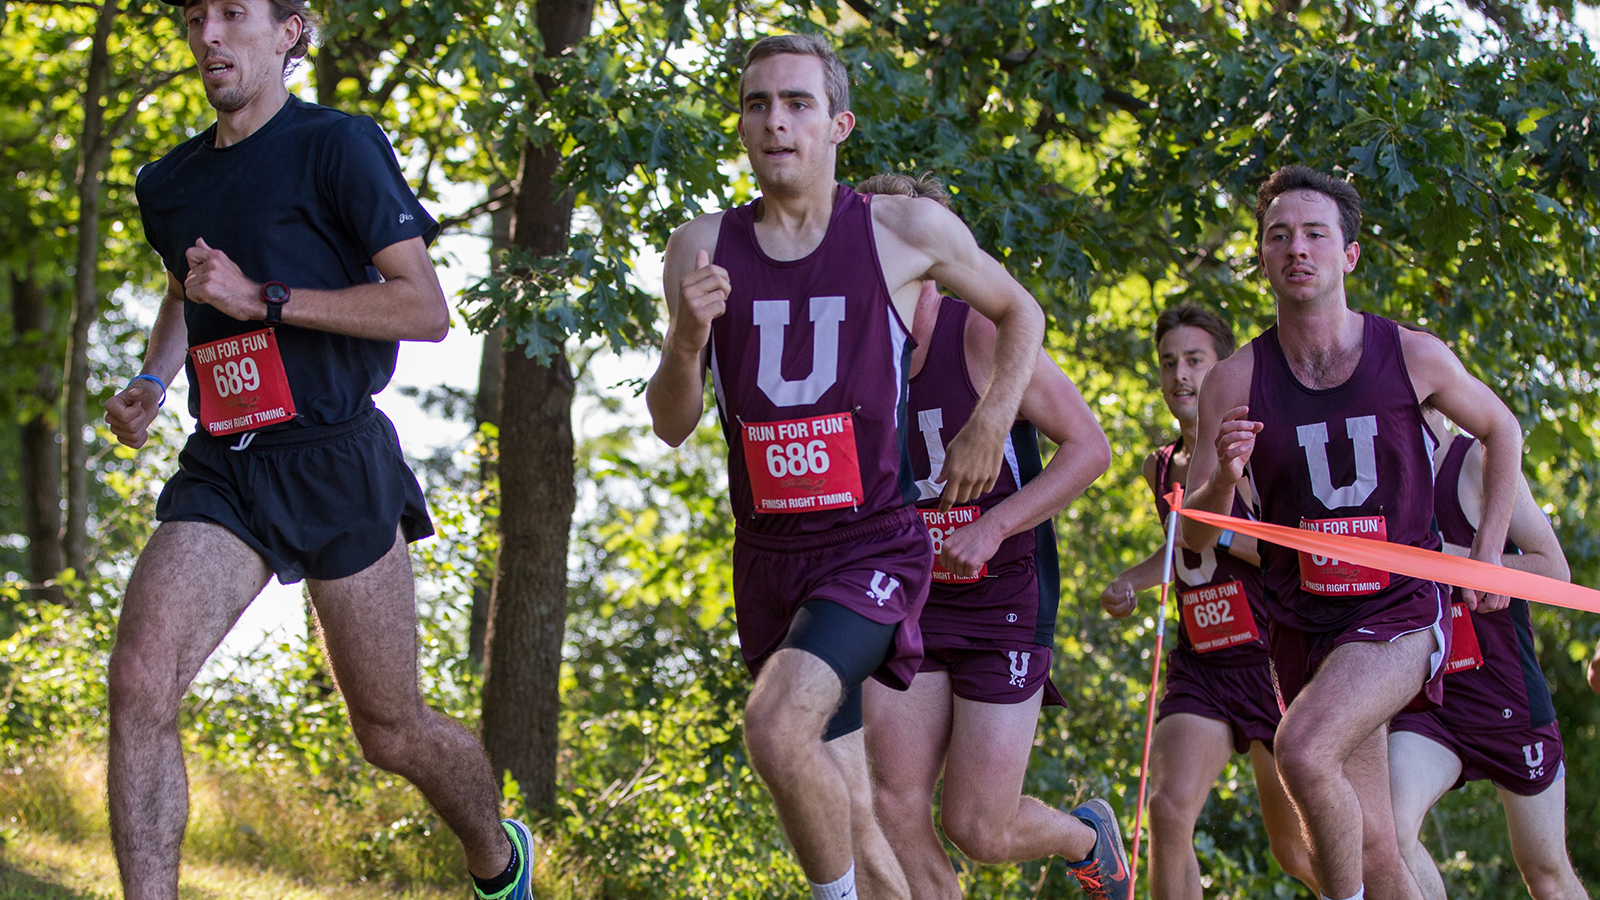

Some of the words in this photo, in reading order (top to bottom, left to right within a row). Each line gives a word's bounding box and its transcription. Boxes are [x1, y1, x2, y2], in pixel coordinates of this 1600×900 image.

[196, 346, 217, 364] RUN
[217, 340, 240, 359] FOR
[241, 333, 268, 353] FUN
[753, 295, 846, 408] U
[212, 357, 260, 398] 689
[209, 419, 233, 432] FINISH
[233, 414, 253, 428] RIGHT
[254, 407, 286, 423] TIMING
[748, 425, 775, 441] RUN
[778, 422, 809, 440] FOR
[812, 417, 844, 436] FUN
[766, 439, 830, 478] 686
[1296, 415, 1378, 511] U
[761, 499, 787, 509] FINISH
[788, 496, 816, 508] RIGHT
[817, 491, 853, 506] TIMING
[922, 512, 946, 525] FOR
[947, 509, 973, 524] FUN
[1322, 521, 1349, 535] FOR
[1352, 519, 1378, 534] FUN
[870, 569, 900, 600] U
[932, 571, 951, 580] RIGHT
[1305, 580, 1325, 592] FINISH
[1326, 583, 1350, 593] RIGHT
[1351, 582, 1381, 592] TIMING
[1183, 593, 1199, 606] RUN
[1199, 588, 1218, 602] FOR
[1218, 584, 1238, 598] FUN
[1193, 599, 1235, 629] 682
[1194, 640, 1212, 651] FINISH
[1211, 637, 1229, 647] RIGHT
[1229, 631, 1252, 643] TIMING
[1008, 650, 1031, 677] U
[1450, 657, 1475, 670] TIMING
[1008, 674, 1026, 688] X-C
[1522, 741, 1544, 768] U
[1528, 766, 1545, 780] X-C
